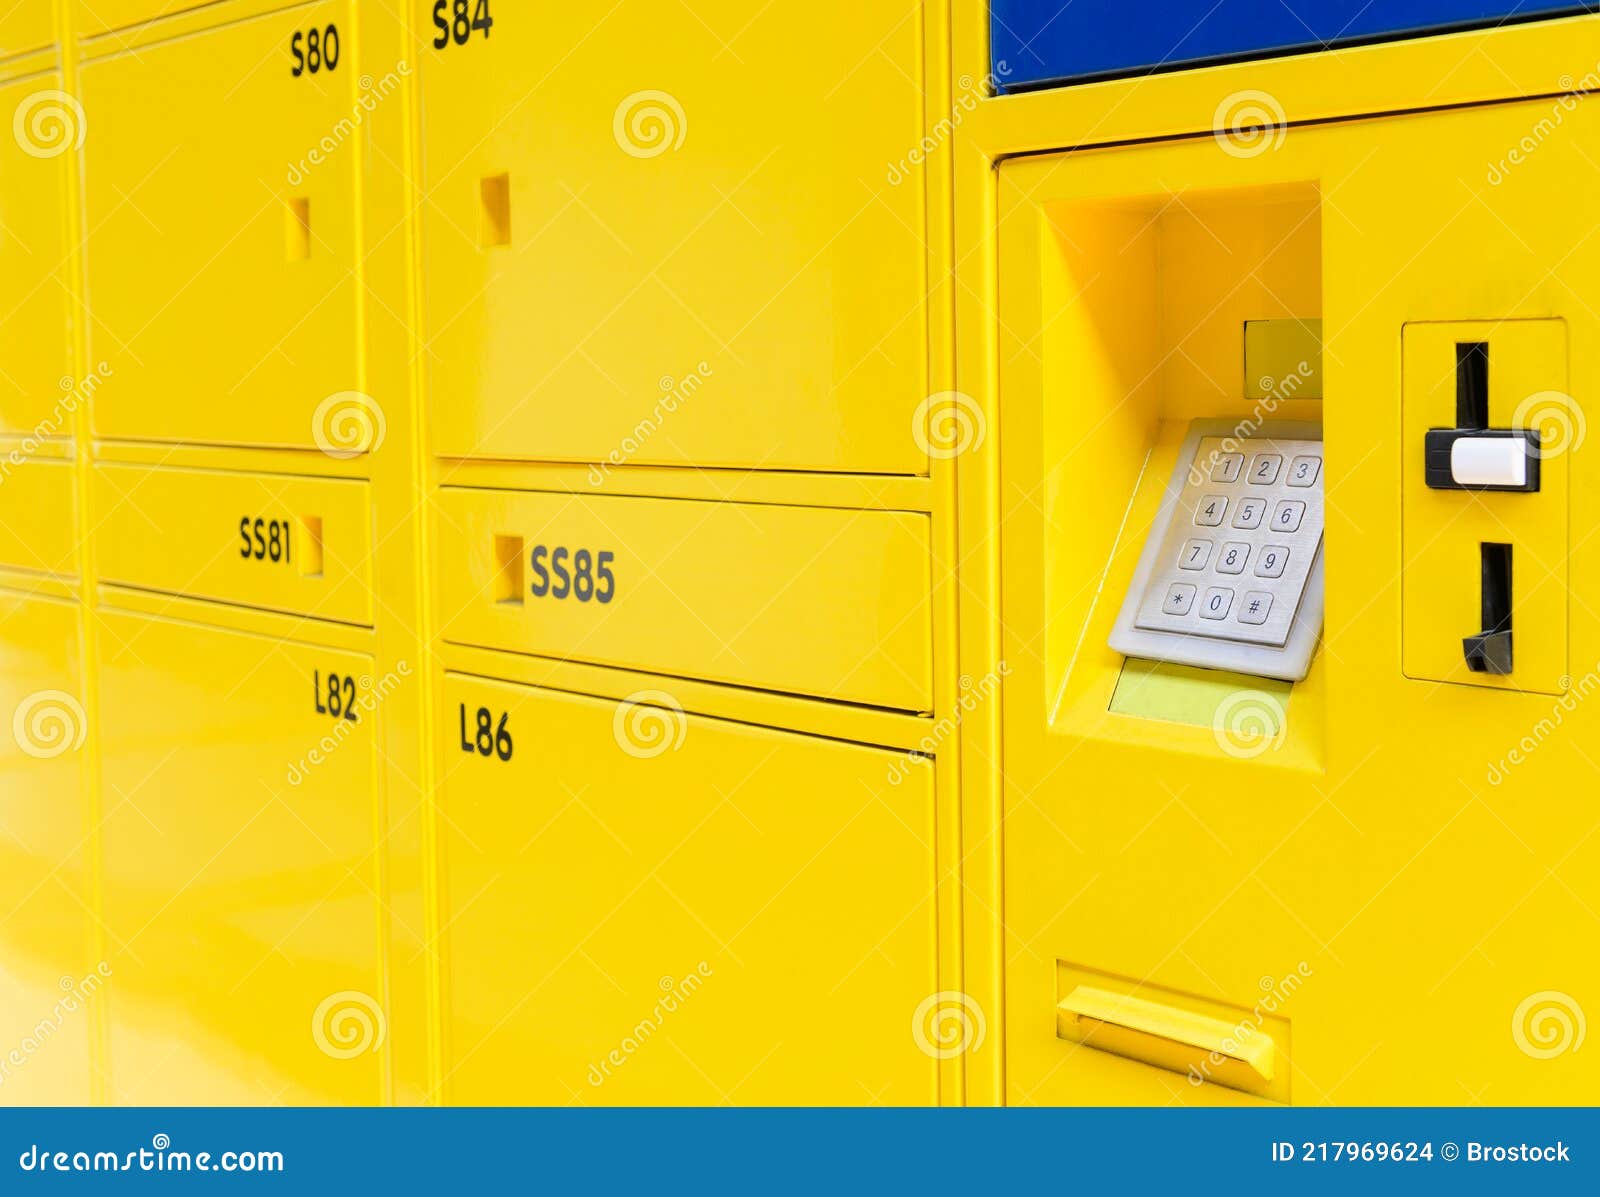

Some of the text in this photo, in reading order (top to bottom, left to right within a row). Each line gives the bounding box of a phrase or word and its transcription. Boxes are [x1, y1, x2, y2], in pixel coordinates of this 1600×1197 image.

[432, 0, 493, 50] S84
[291, 23, 340, 78] S80
[1222, 459, 1308, 479] 1 2 3
[1204, 502, 1293, 524] 4 5 6
[240, 516, 290, 563] SS81
[1189, 546, 1276, 569] 7 8 9
[531, 545, 615, 604] SS85
[1210, 595, 1222, 611] 0
[315, 670, 358, 721] L82
[460, 703, 513, 762] L86
